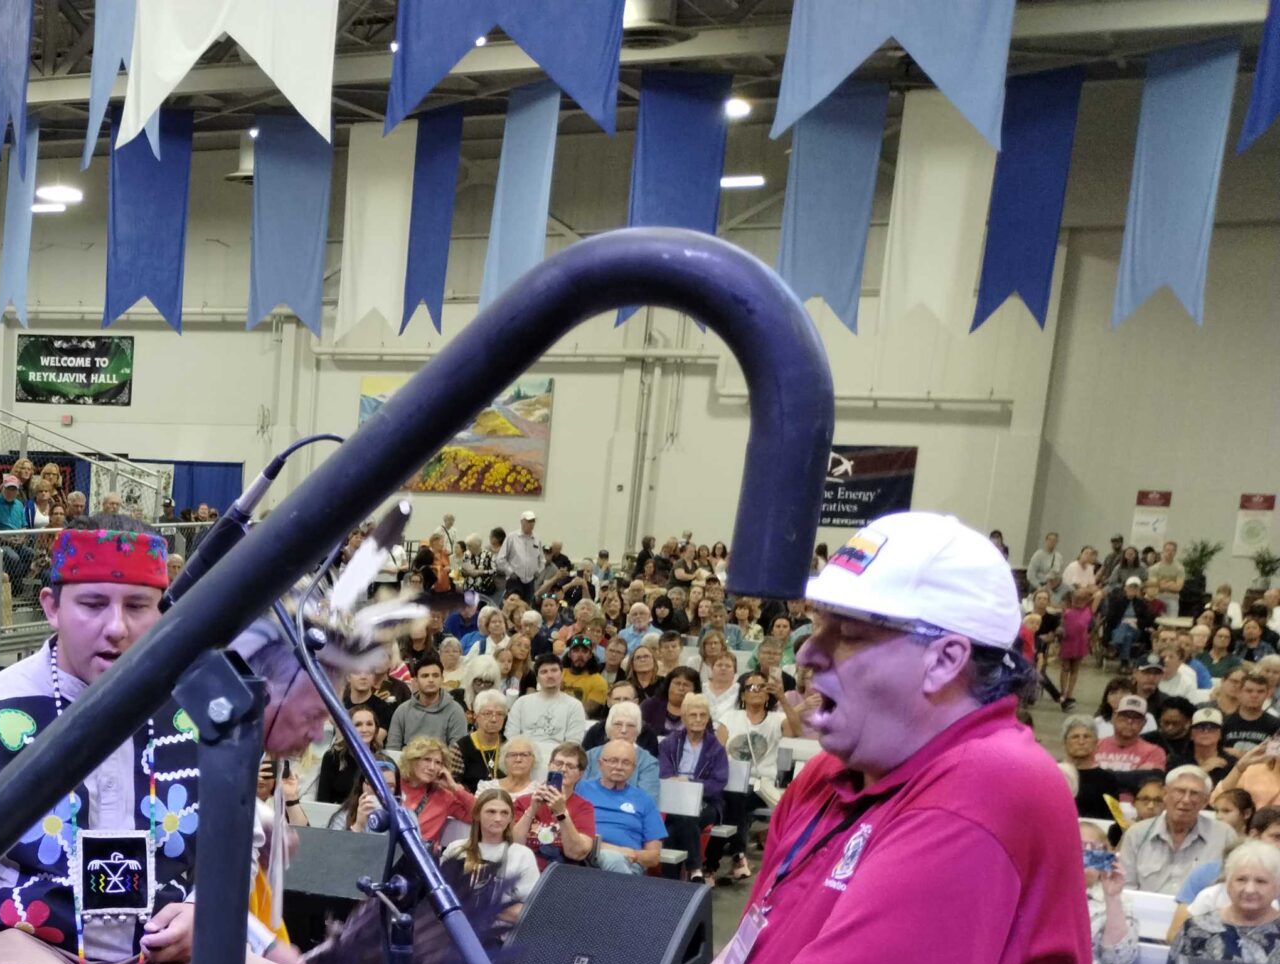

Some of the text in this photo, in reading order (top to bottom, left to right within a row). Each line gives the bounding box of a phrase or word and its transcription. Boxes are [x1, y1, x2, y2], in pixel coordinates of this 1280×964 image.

[40, 356, 109, 368] WELCOME TO
[28, 371, 119, 384] REYKJAVIK HALL
[837, 487, 877, 502] Energy
